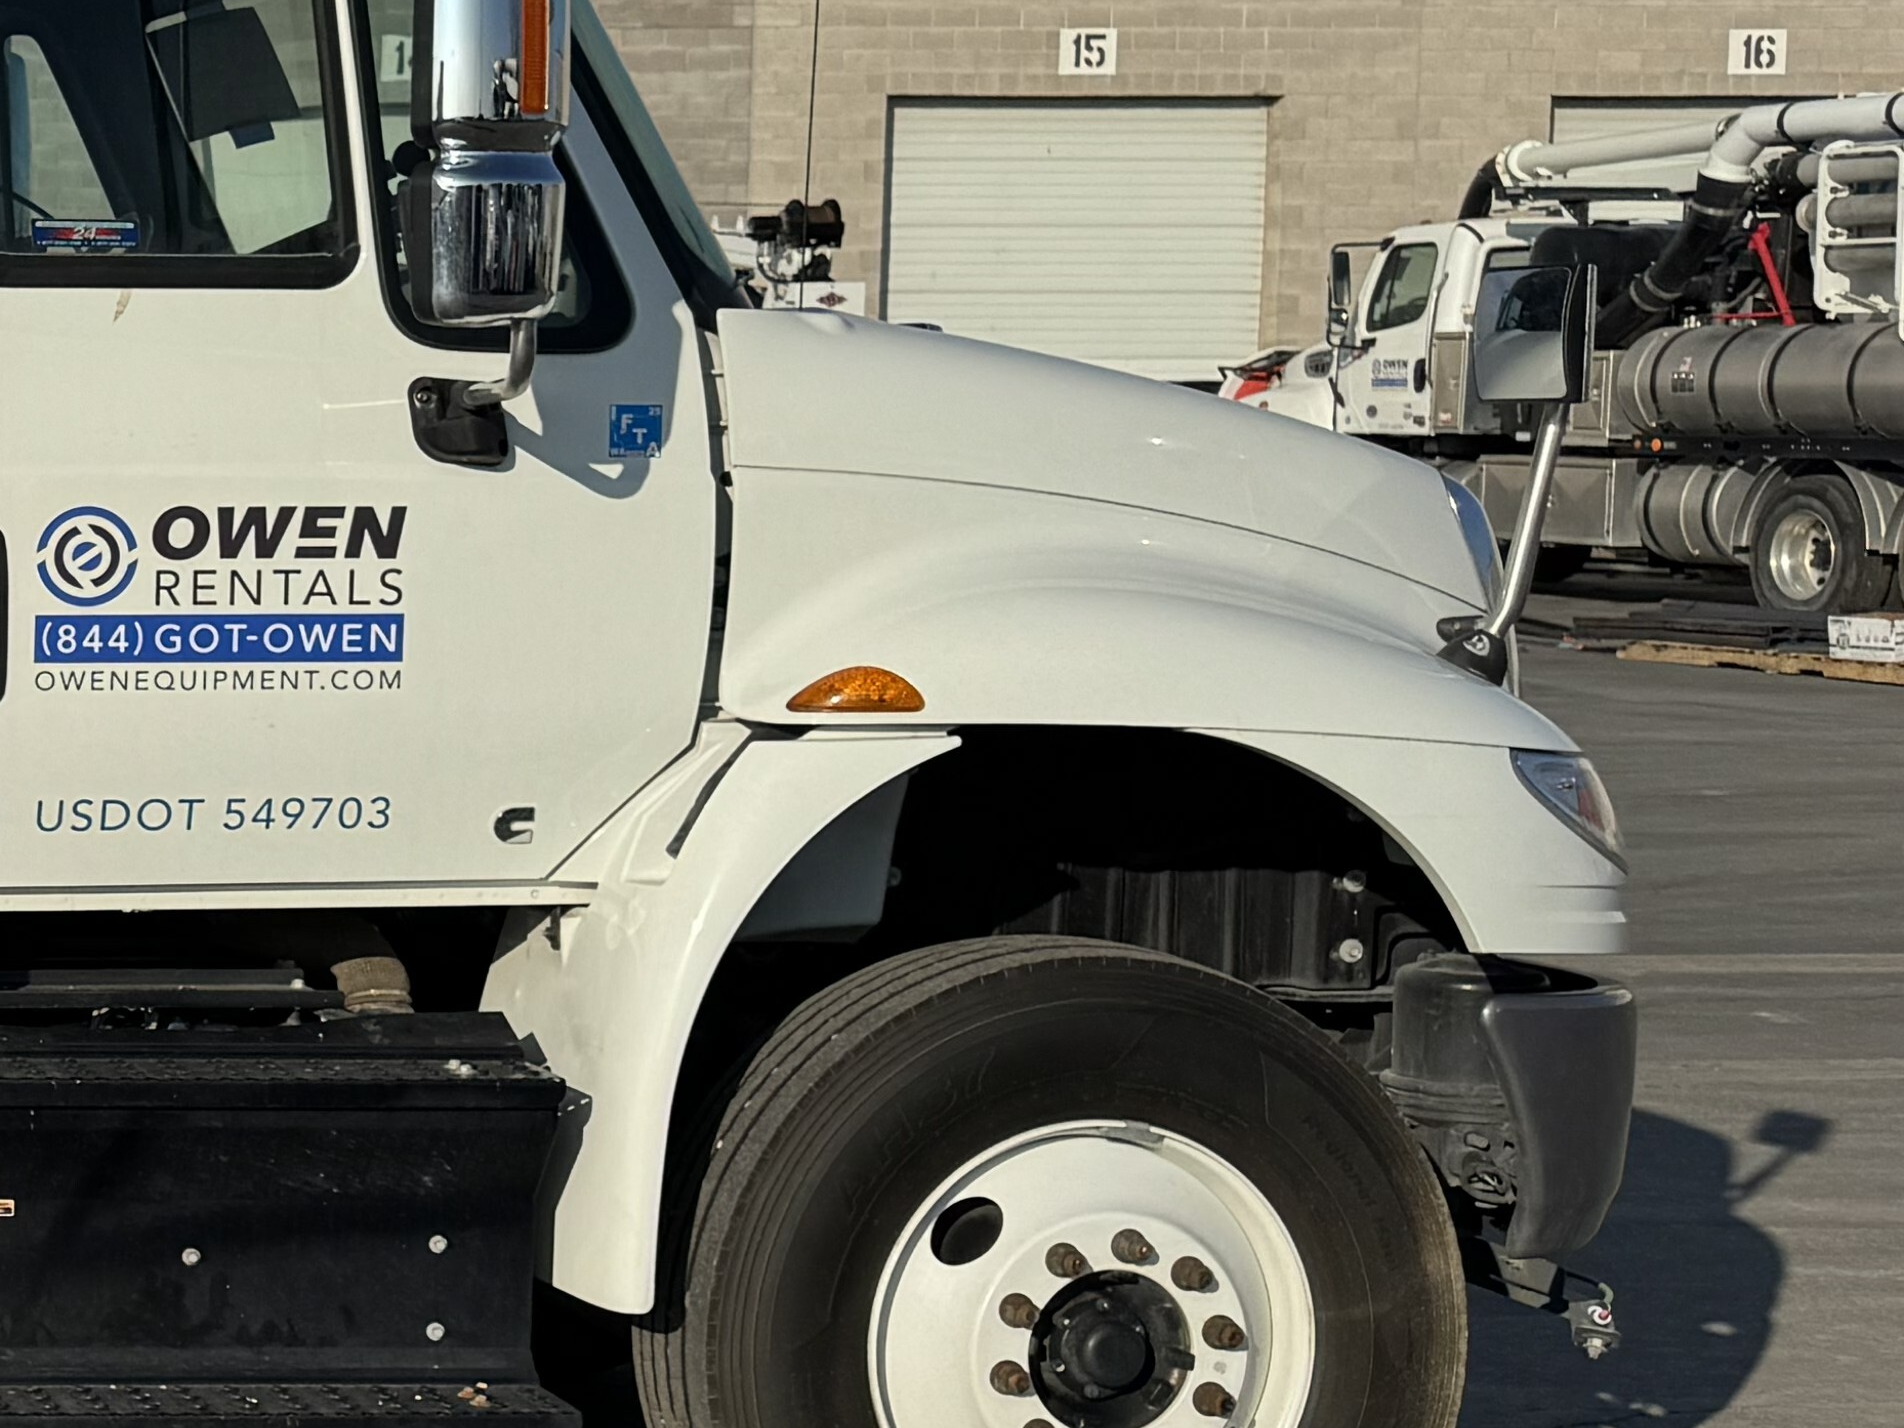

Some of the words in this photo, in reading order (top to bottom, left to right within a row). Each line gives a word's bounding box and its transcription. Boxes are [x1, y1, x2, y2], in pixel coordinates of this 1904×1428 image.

[395, 40, 413, 75] 1
[1073, 33, 1107, 68] 15
[1743, 34, 1776, 69] 16
[152, 505, 408, 560] OWEN
[155, 569, 404, 606] RENTALS
[41, 621, 144, 656] (844)
[154, 623, 398, 654] GOT-OWEN
[35, 670, 402, 691] OWENEQUIPMENT.COM
[36, 798, 205, 832] USDOT
[222, 796, 392, 831] 549703
